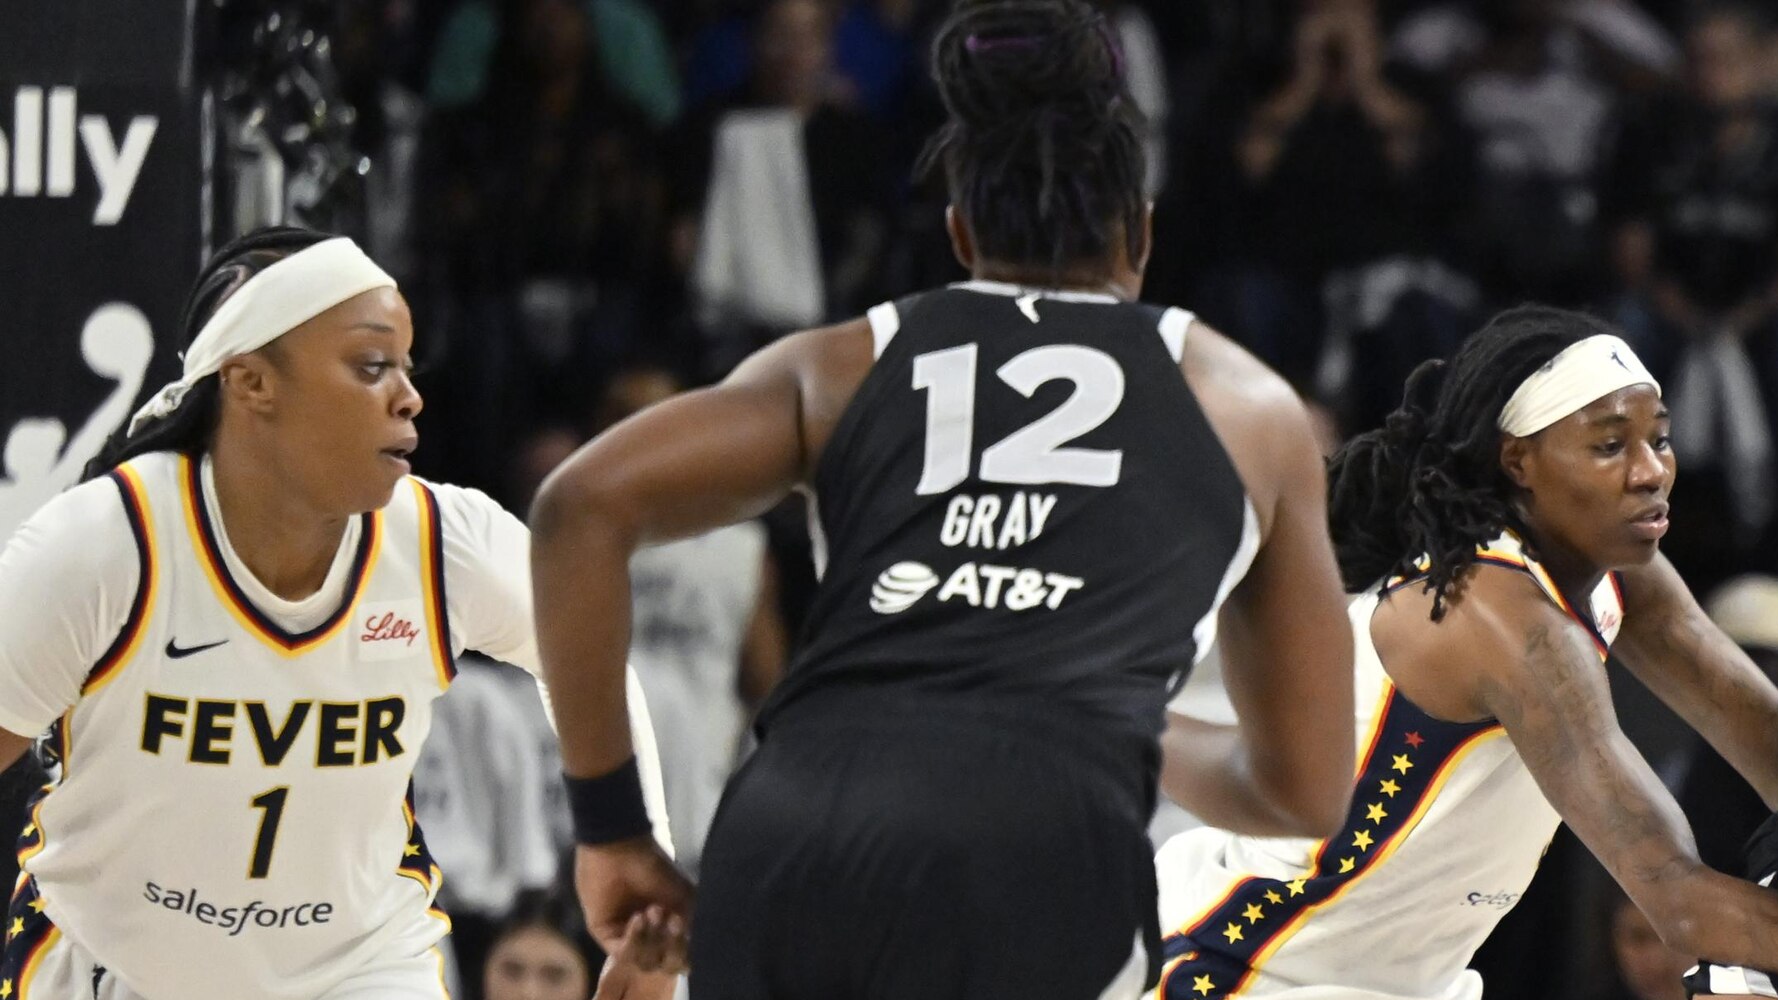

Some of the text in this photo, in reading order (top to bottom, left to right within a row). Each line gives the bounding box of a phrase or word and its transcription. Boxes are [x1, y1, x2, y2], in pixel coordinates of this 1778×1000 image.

[911, 342, 1125, 495] 12
[940, 491, 1058, 550] GRAY
[937, 561, 1085, 611] AT&T
[361, 612, 420, 647] Lilly
[139, 690, 406, 769] FEVER
[246, 784, 291, 881] 1
[143, 881, 334, 937] salesforce
